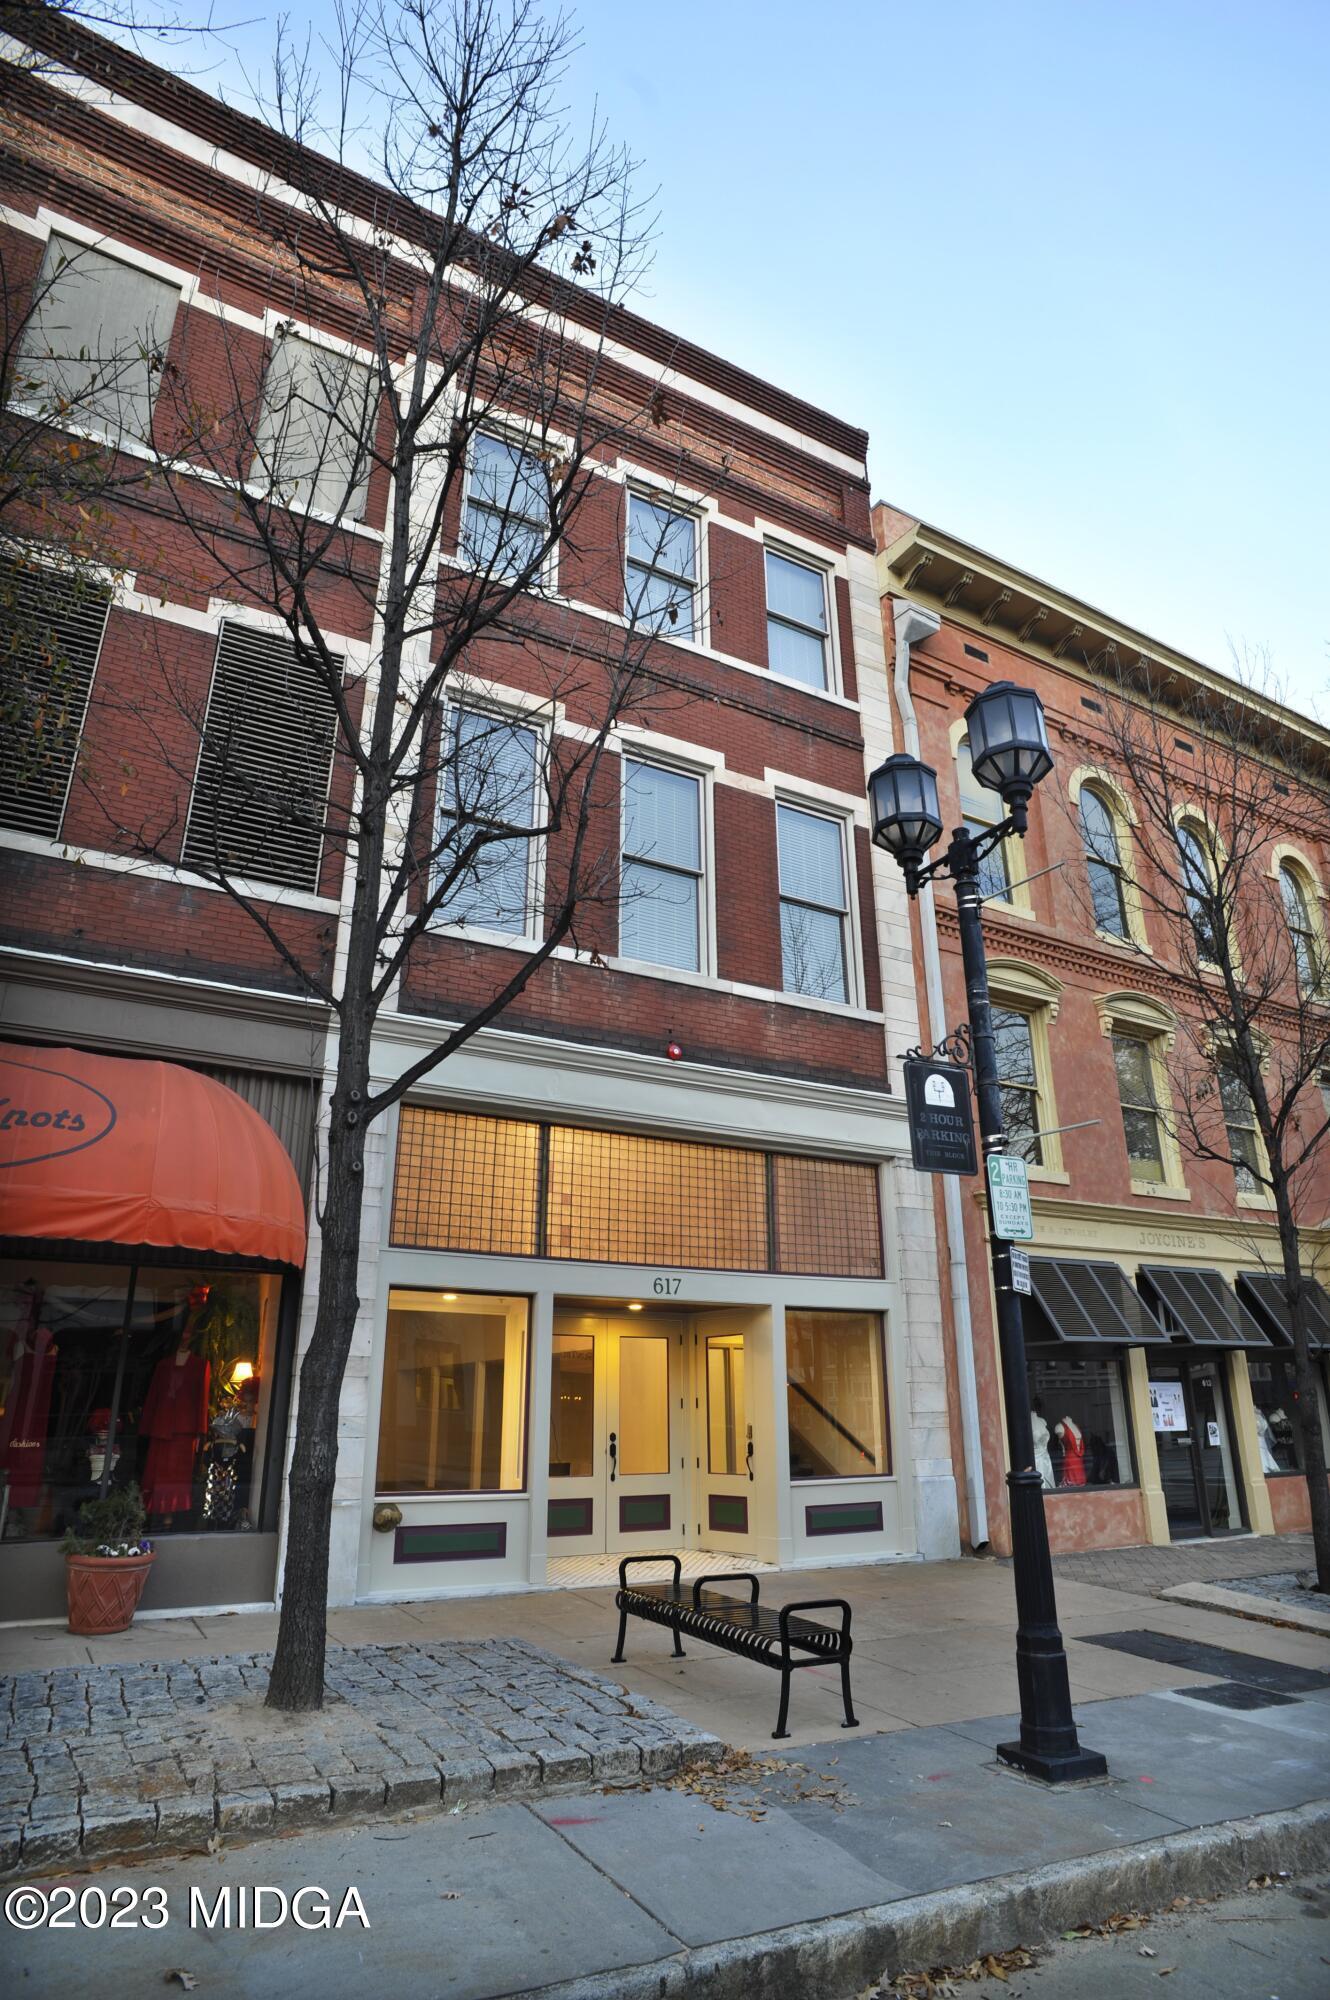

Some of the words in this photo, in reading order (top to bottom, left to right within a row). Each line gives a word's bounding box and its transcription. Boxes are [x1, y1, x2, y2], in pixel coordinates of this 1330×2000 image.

[0, 1098, 85, 1131] nots
[920, 1112, 927, 1122] 2
[928, 1113, 964, 1127] HOUR
[915, 1127, 971, 1145] PARKING
[944, 1151, 966, 1160] BLOCK
[991, 1162, 1000, 1181] 2
[1008, 1160, 1018, 1172] HR
[1002, 1173, 1026, 1186] PARKING
[999, 1189, 1012, 1199] 8:30
[1014, 1189, 1022, 1200] AM
[997, 1201, 1004, 1211] TO
[1005, 1201, 1018, 1212] 5:30
[1019, 1203, 1027, 1212] PM
[1139, 1231, 1207, 1250] JOYCINE'S
[653, 1277, 682, 1295] 617
